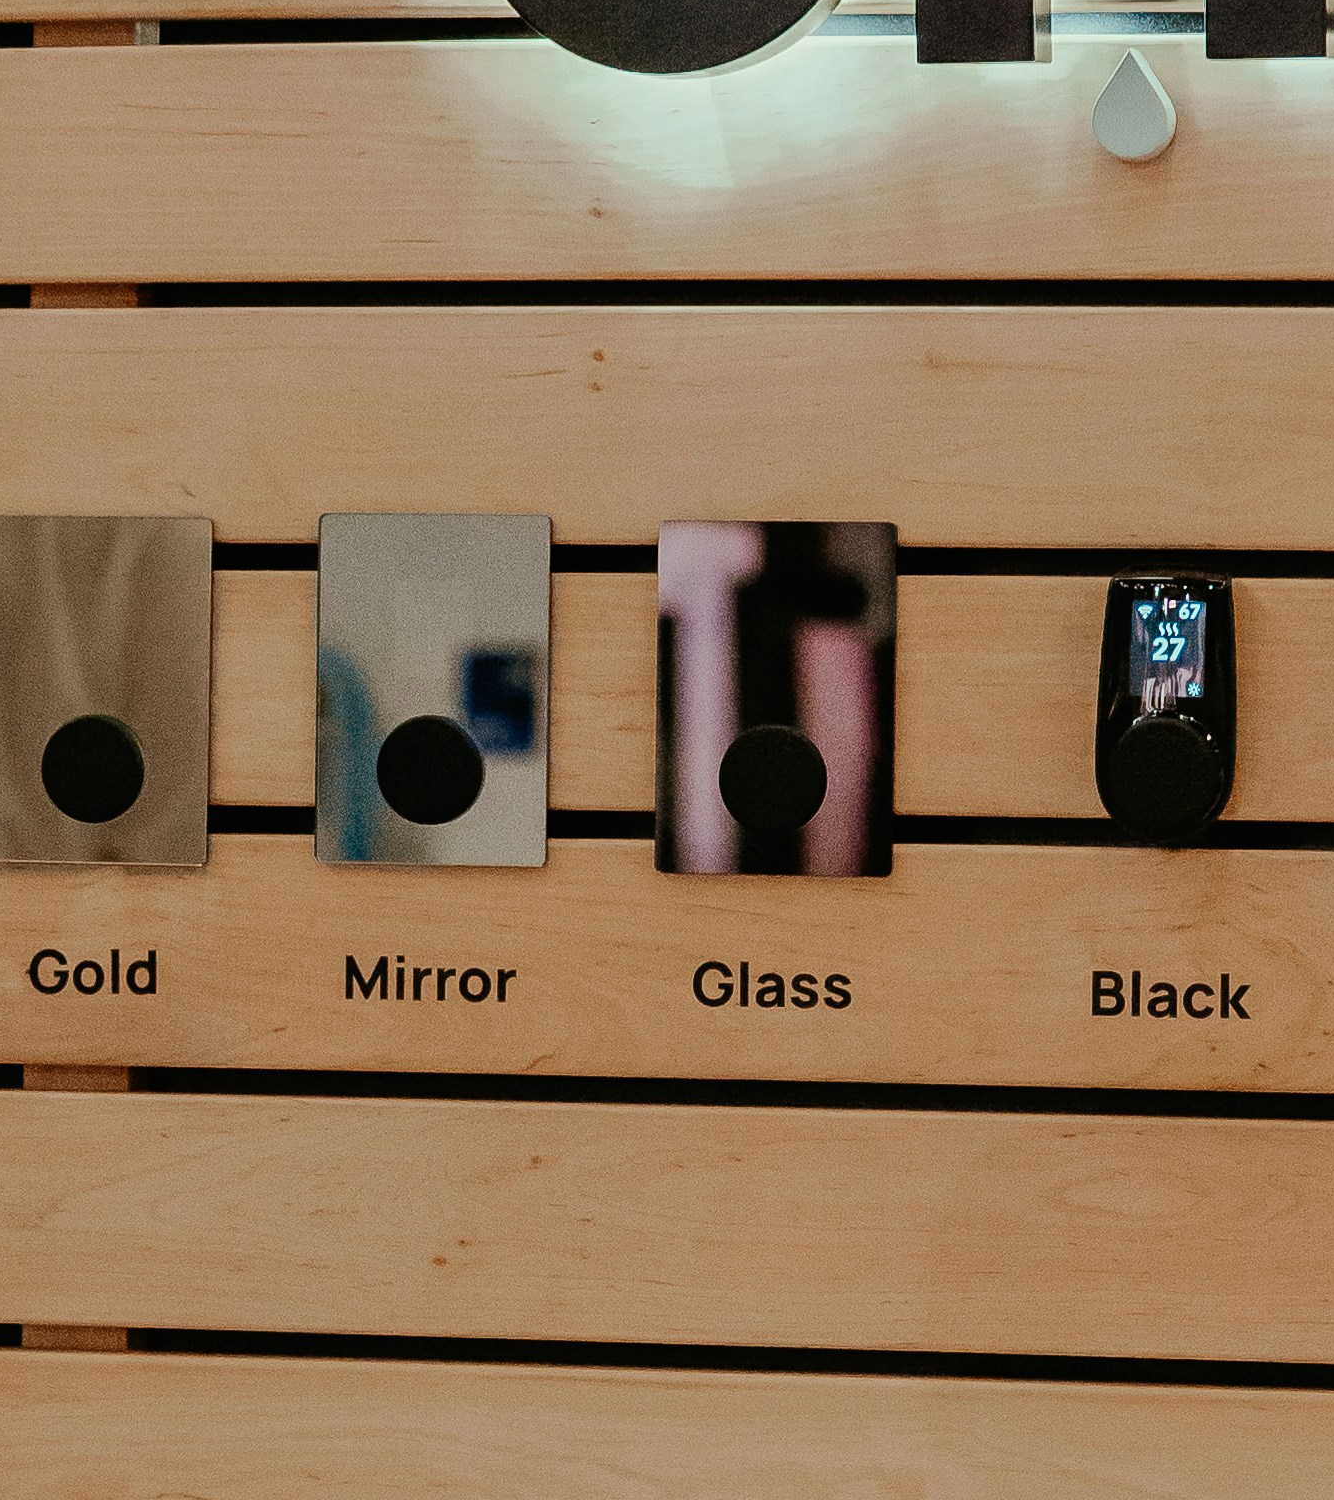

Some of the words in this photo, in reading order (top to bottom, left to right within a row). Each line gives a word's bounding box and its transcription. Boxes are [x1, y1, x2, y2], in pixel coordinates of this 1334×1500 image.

[1178, 603, 1201, 620] 67
[1152, 637, 1186, 662] 27
[27, 949, 157, 995] Gold
[346, 956, 517, 1002] Mirror
[693, 962, 851, 1008] Glass
[1092, 971, 1250, 1019] Black
